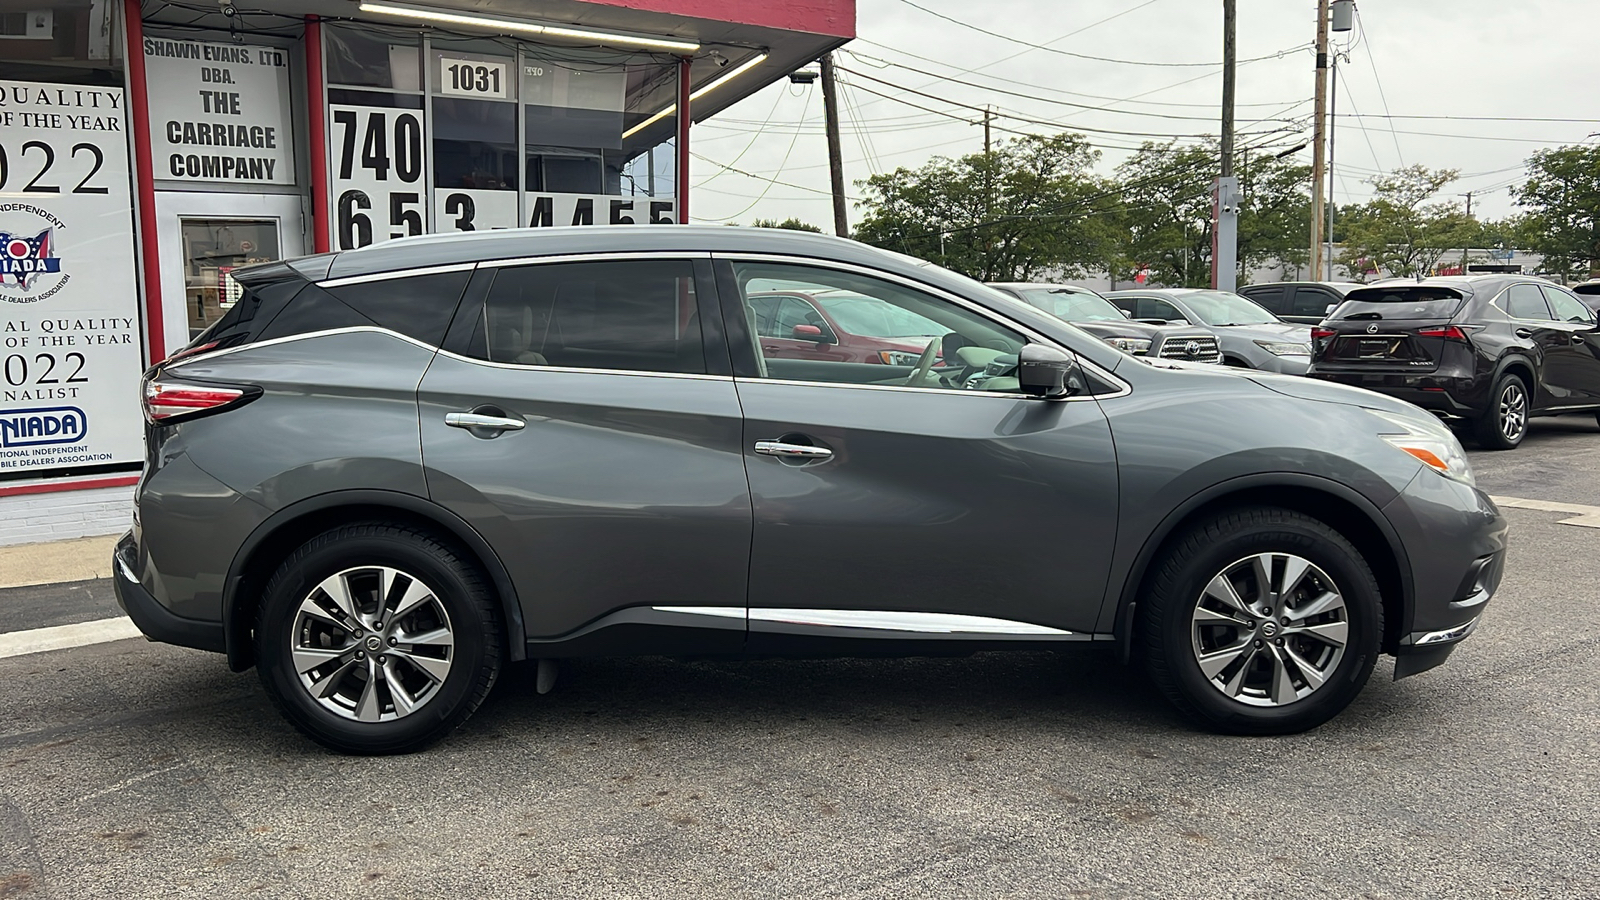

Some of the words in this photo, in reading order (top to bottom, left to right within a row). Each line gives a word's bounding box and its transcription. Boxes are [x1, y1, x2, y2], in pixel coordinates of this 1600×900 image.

[144, 39, 201, 60] SHAWN
[203, 45, 253, 64] EVANS.
[259, 50, 287, 67] LTD.
[201, 67, 236, 84] DBA.
[448, 64, 500, 93] 1031
[199, 90, 241, 115] THE
[0, 112, 14, 127] F
[19, 112, 62, 129] THE
[66, 114, 121, 132] YEAR
[166, 120, 276, 149] CARRIAGE
[334, 110, 422, 183] 740
[169, 153, 276, 180] COMPANY
[8, 295, 38, 304] DEALERS
[38, 273, 71, 302] ASSOCIATION
[4, 321, 31, 333] AL
[40, 318, 133, 334] QUALITY
[5, 337, 29, 348] OF
[38, 335, 76, 347] THE
[84, 333, 132, 345] YEAR
[4, 351, 89, 387] 022
[4, 387, 80, 402] NALIST
[2, 414, 78, 439] NIADA
[0, 460, 17, 468] BILE
[20, 457, 55, 467] DEALERS
[57, 453, 113, 464] ASSOCIATION
[32, 445, 88, 456] INDEPENDENT
